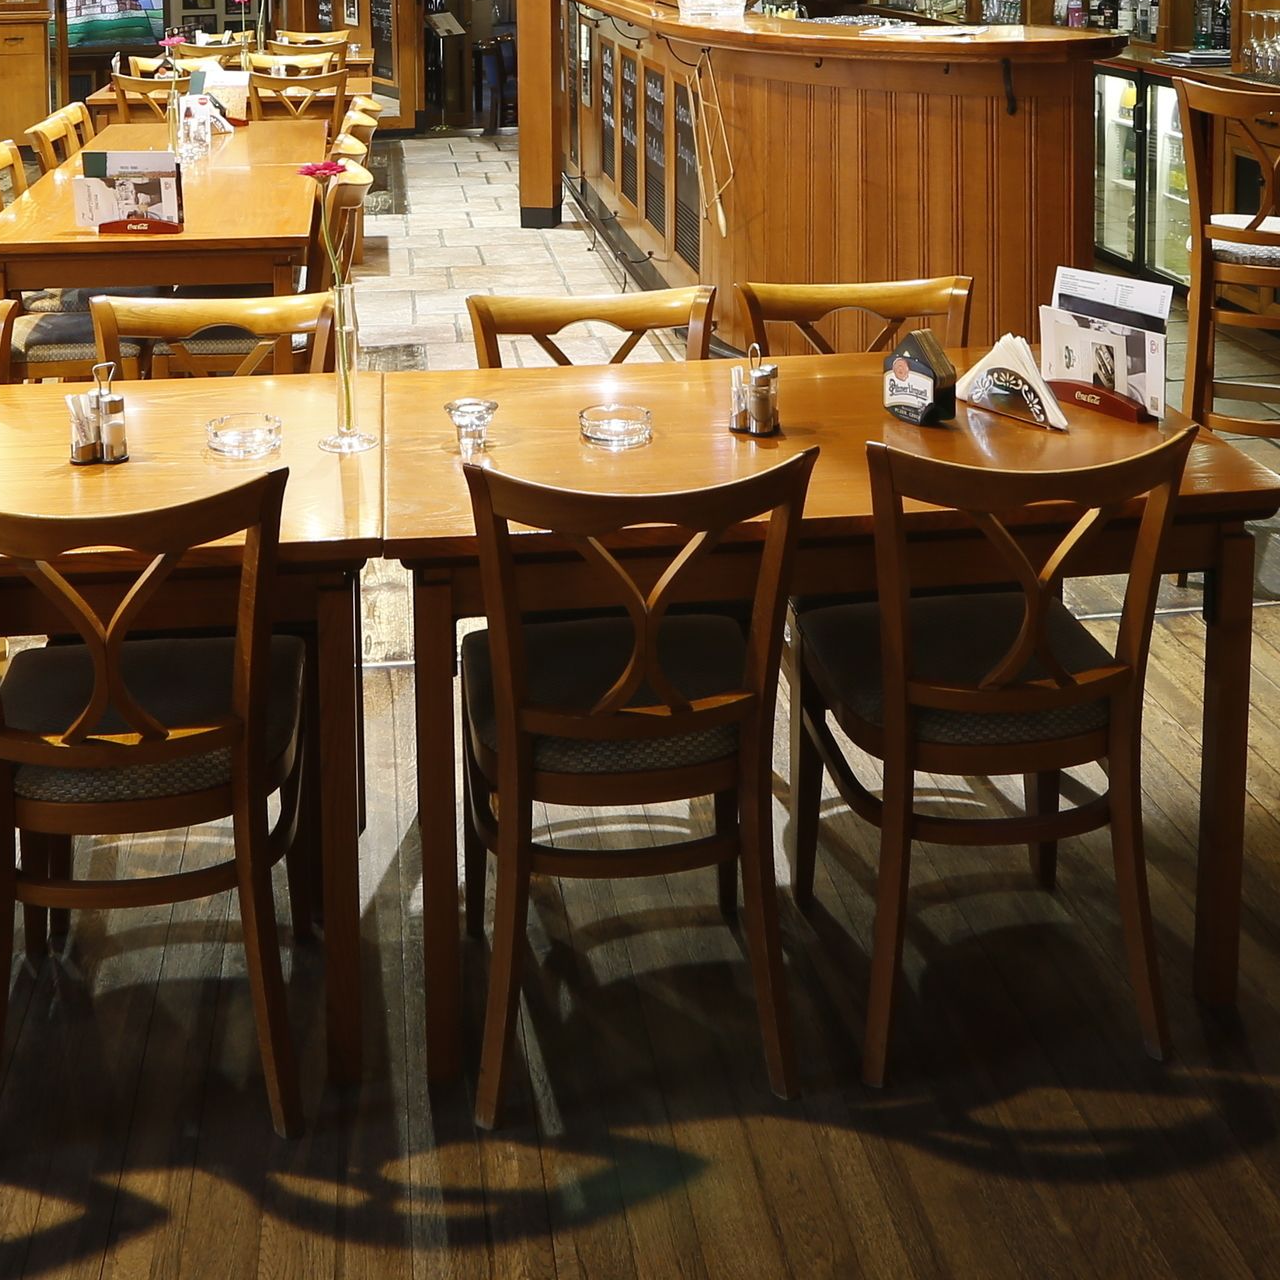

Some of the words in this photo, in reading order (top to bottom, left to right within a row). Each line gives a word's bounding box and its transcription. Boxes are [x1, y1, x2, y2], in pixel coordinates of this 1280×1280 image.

[889, 378, 908, 397] Pilsner
[908, 382, 928, 397] Urquell
[1075, 390, 1100, 405] Coca-Cola
